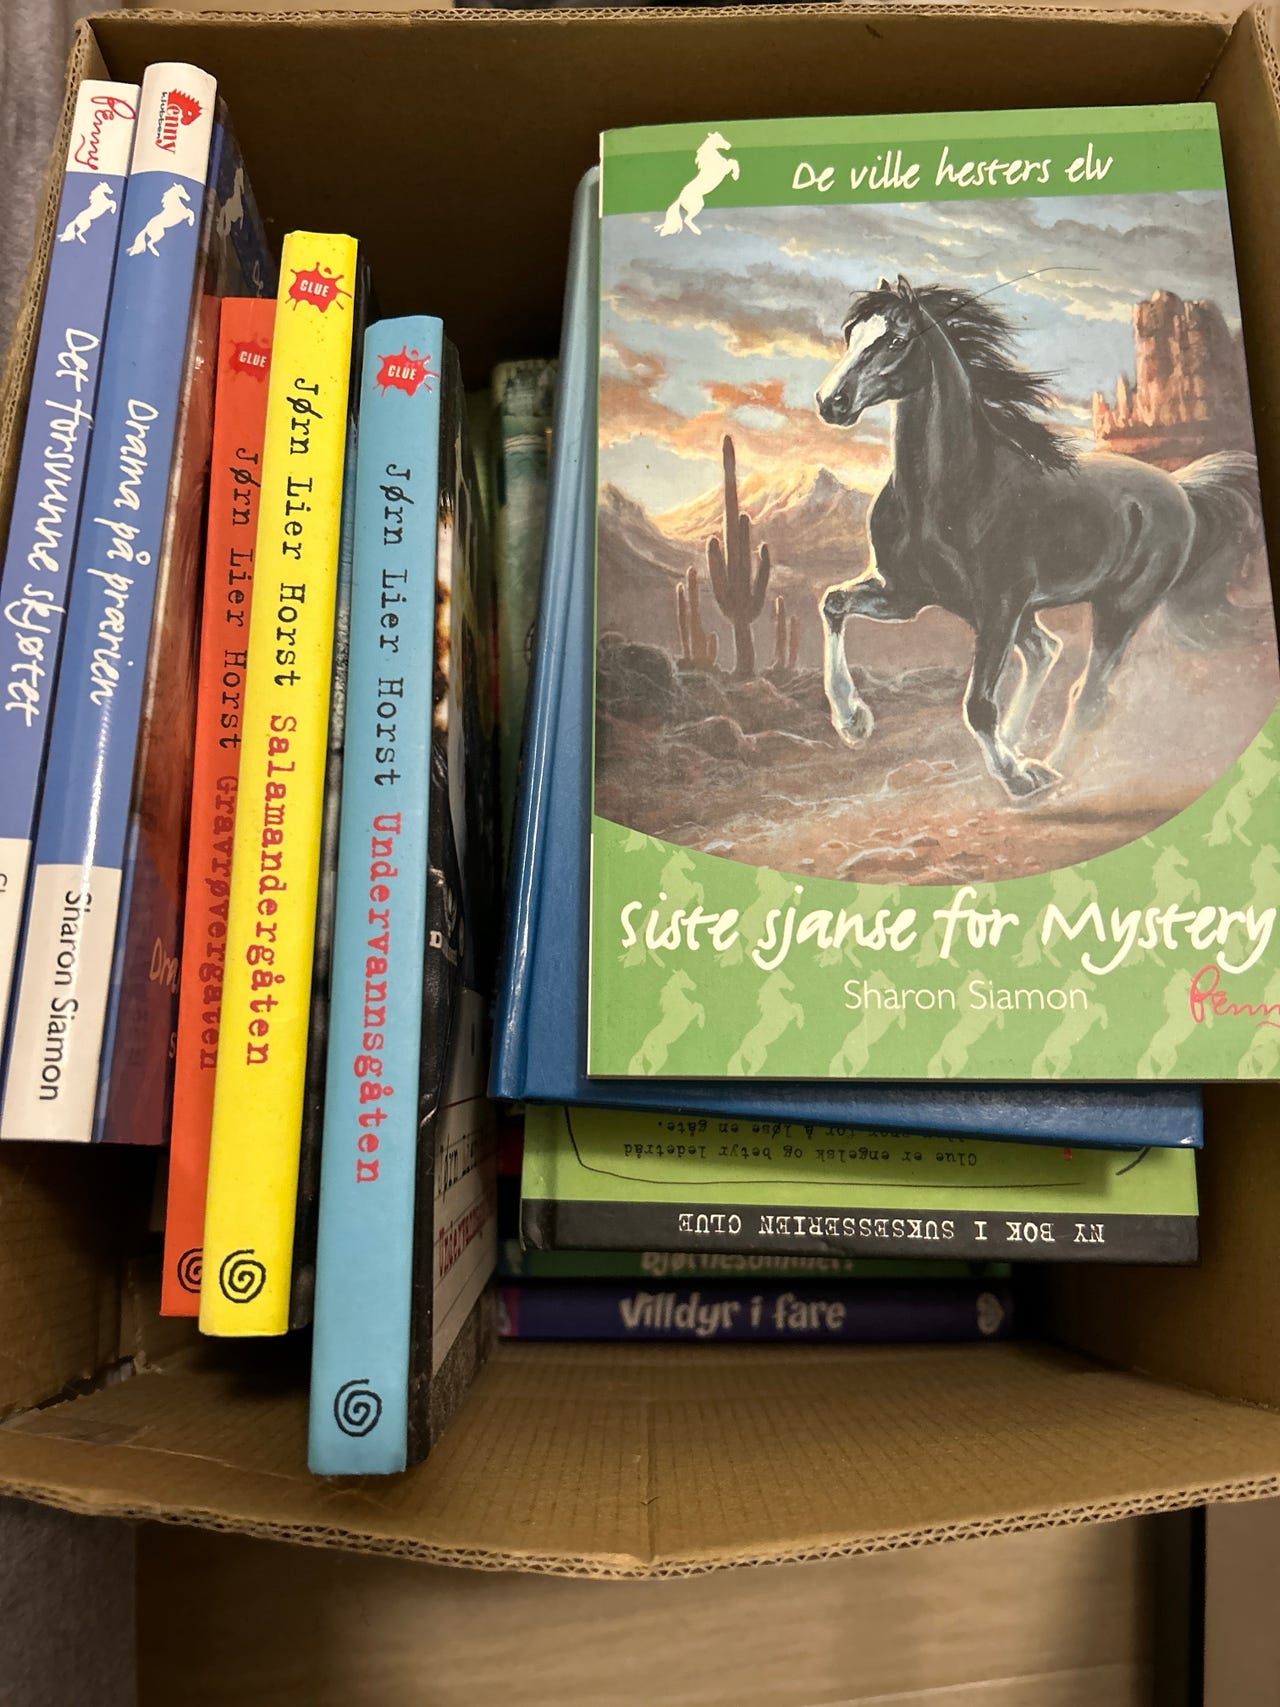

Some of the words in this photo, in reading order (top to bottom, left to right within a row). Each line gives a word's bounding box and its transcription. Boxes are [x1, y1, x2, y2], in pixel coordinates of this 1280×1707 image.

[75, 95, 136, 170] Penny
[791, 162, 835, 192] De
[850, 150, 920, 189] ville
[936, 146, 1051, 187] hesters
[1065, 142, 1114, 183] elv
[300, 279, 330, 297] CLUE
[56, 328, 100, 392] Det
[238, 350, 267, 369] CLUE
[387, 365, 417, 381] CLUE
[286, 377, 323, 455] Jørn
[114, 398, 159, 511] Drama
[27, 398, 93, 572] forsvunne
[229, 447, 261, 526] Jørn
[379, 463, 414, 546] Jørn
[94, 516, 151, 566] på
[282, 476, 312, 560] Lier
[226, 548, 253, 627] Lier
[379, 568, 407, 653] Lier
[4, 583, 67, 727] skjøtet
[87, 568, 134, 705] prærien
[274, 583, 305, 686] Horst
[219, 650, 248, 748] Horst
[374, 677, 404, 785] Horst
[246, 714, 298, 1066] Salamandergåten
[54, 889, 92, 986] Sharon
[752, 885, 917, 971] sjanse
[933, 886, 1019, 959] for
[1041, 902, 1277, 975] Mystery
[353, 812, 401, 1183] Undervannsgåten
[844, 979, 956, 1010] Sharon
[969, 979, 1088, 1010] Siamon
[1189, 964, 1280, 1024] Penn
[38, 997, 78, 1101] Siamon
[623, 1142, 706, 1158] ledetråd
[718, 1123, 738, 1134] en
[718, 1143, 771, 1160] betyr
[752, 1122, 792, 1140] løse
[783, 1145, 803, 1159] og
[816, 1147, 890, 1163] engelsk
[902, 1151, 922, 1163] er
[935, 1152, 977, 1167] Clue
[678, 1212, 742, 1234] CLUE
[758, 1214, 954, 1240] SUKSESSERIEN
[973, 1220, 988, 1240] I
[1005, 1220, 1055, 1242] BOK
[1074, 1222, 1105, 1243] NY
[618, 1292, 740, 1336] Villdyr
[749, 1295, 763, 1328] i
[772, 1293, 846, 1330] fare
